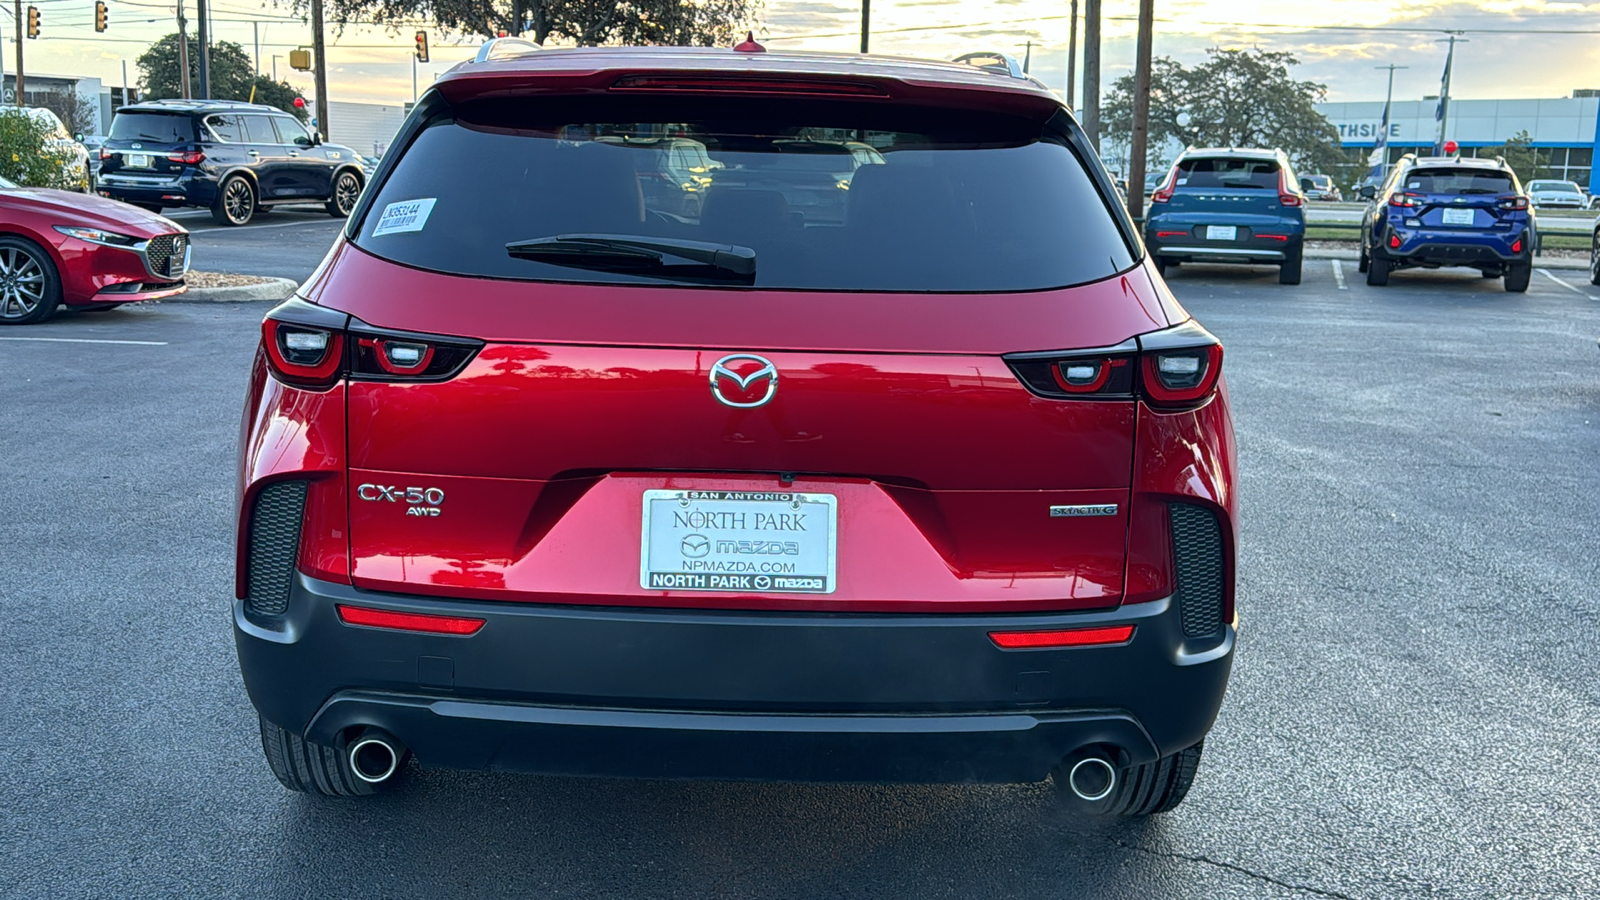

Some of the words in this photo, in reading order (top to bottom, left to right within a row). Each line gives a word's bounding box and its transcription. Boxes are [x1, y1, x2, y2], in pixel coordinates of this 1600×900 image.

[1338, 123, 1401, 137] THSIE
[357, 483, 444, 506] CX-50
[690, 492, 720, 500] SAN
[725, 493, 790, 501] ANTONIO
[405, 506, 441, 517] AWD
[672, 510, 746, 530] NORTH
[754, 511, 808, 532] PARK
[716, 539, 800, 556] mazda
[682, 560, 796, 573] NPMAZDA.COM
[652, 573, 706, 587] NORTH
[710, 575, 751, 588] PARK
[774, 577, 823, 589] mazda
